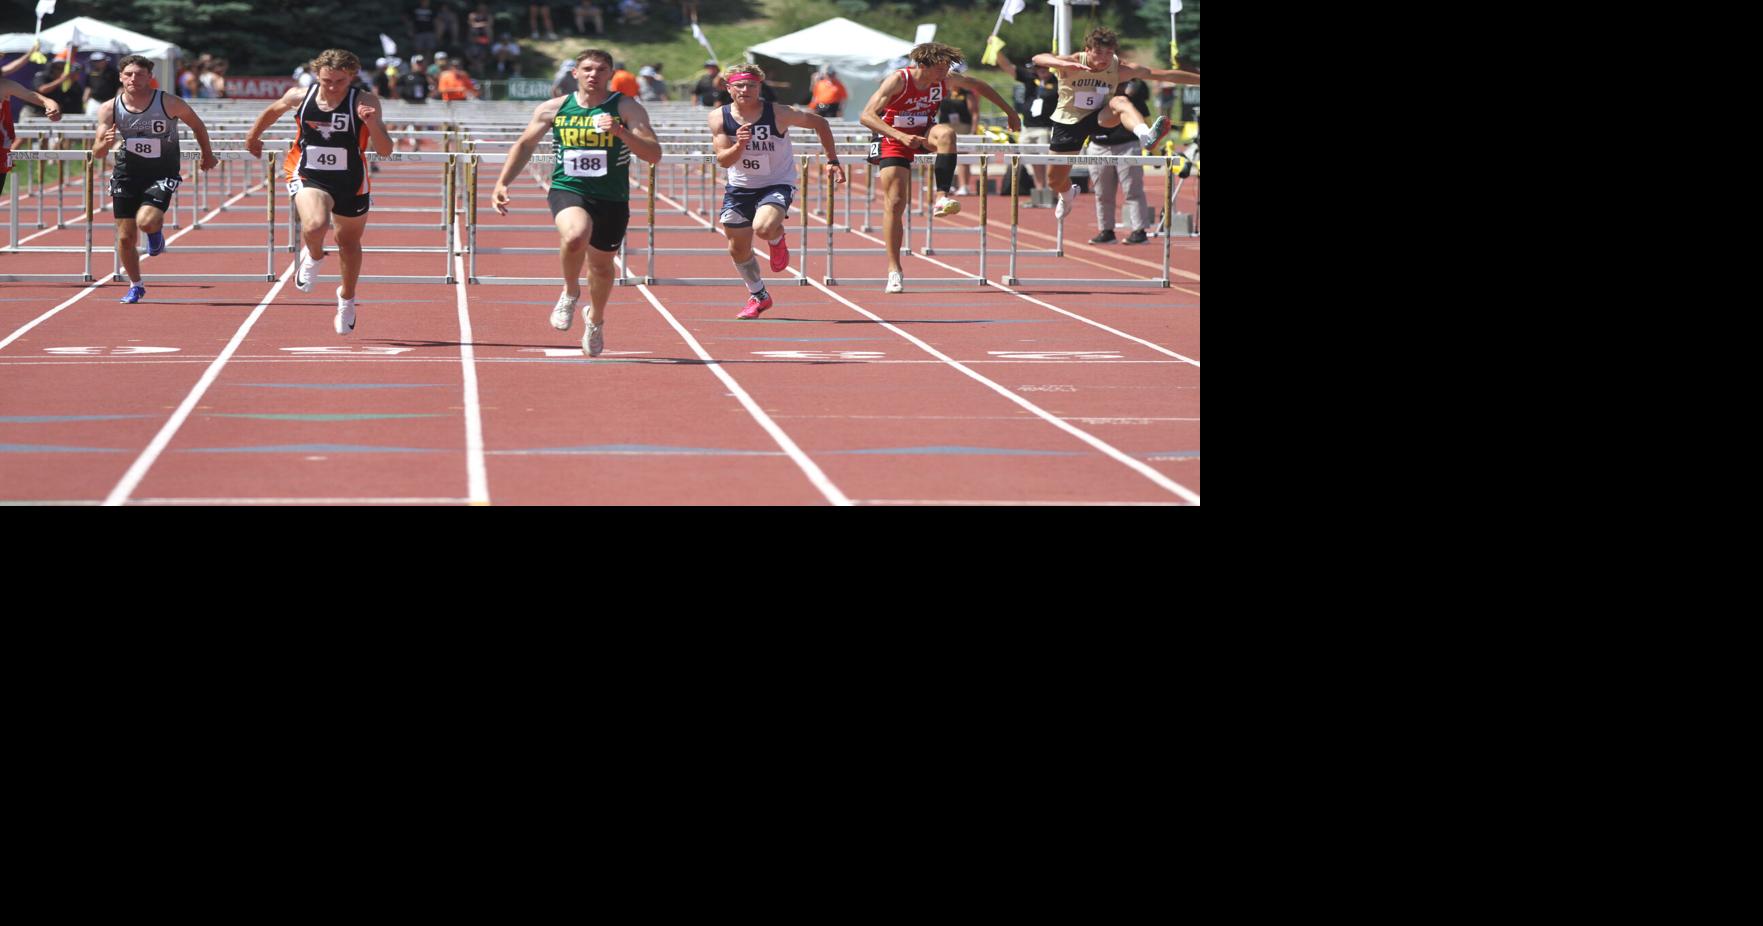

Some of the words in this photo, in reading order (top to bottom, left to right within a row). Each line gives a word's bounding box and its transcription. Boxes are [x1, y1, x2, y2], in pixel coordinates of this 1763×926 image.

[932, 88, 940, 101] 2
[1086, 97, 1094, 106] 5
[153, 120, 164, 133] 6
[333, 115, 346, 130] 5
[907, 117, 915, 126] 3
[559, 128, 614, 147] IRISH
[756, 126, 769, 140] 3
[134, 143, 152, 154] 88
[871, 144, 878, 155] 2
[317, 153, 337, 166] 49
[570, 157, 602, 171] 188
[742, 158, 760, 170] 96
